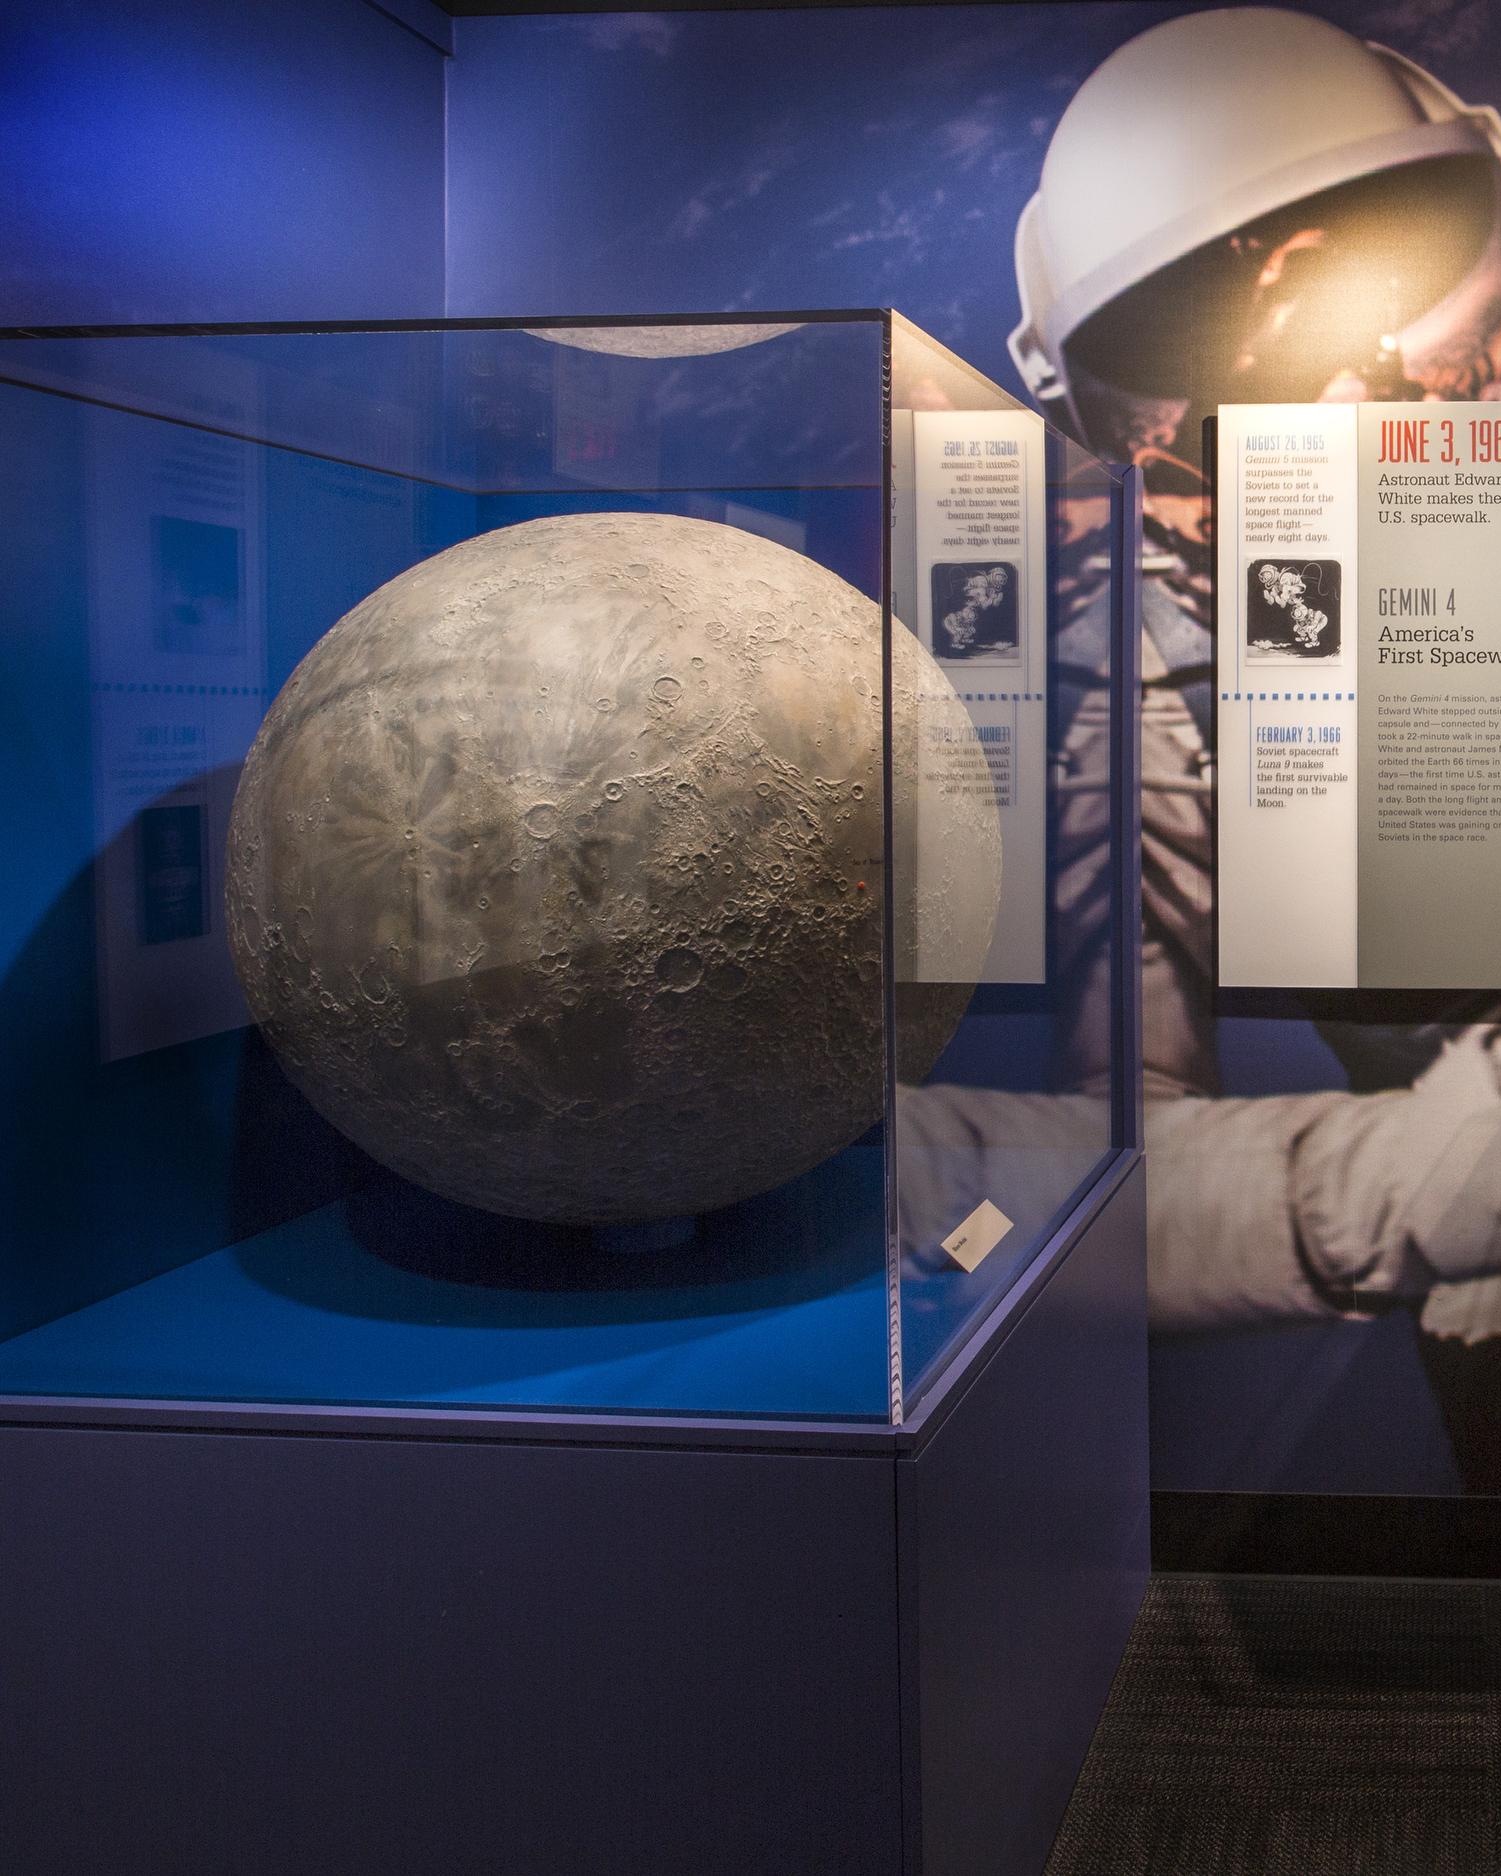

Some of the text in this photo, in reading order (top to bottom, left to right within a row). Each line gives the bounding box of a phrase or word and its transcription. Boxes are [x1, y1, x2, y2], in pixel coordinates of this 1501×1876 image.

[1245, 435, 1325, 452] AUGUST 26, 1965
[1378, 420, 1430, 463] JUNE
[1378, 473, 1450, 486] Astronaut
[1378, 492, 1422, 505] White
[1426, 492, 1474, 505] makes
[1478, 491, 1501, 505] the
[1378, 510, 1491, 526] U.S. spacewalk.
[1378, 588, 1456, 616] GEMINI 4
[1378, 647, 1424, 664] First
[1377, 694, 1391, 703] On
[1393, 694, 1408, 703] the
[1410, 694, 1442, 703] Gemini
[1444, 694, 1450, 702] 4
[1451, 694, 1488, 704] mission,
[1256, 726, 1304, 744] FEBRUARY
[1318, 726, 1341, 744] 1966
